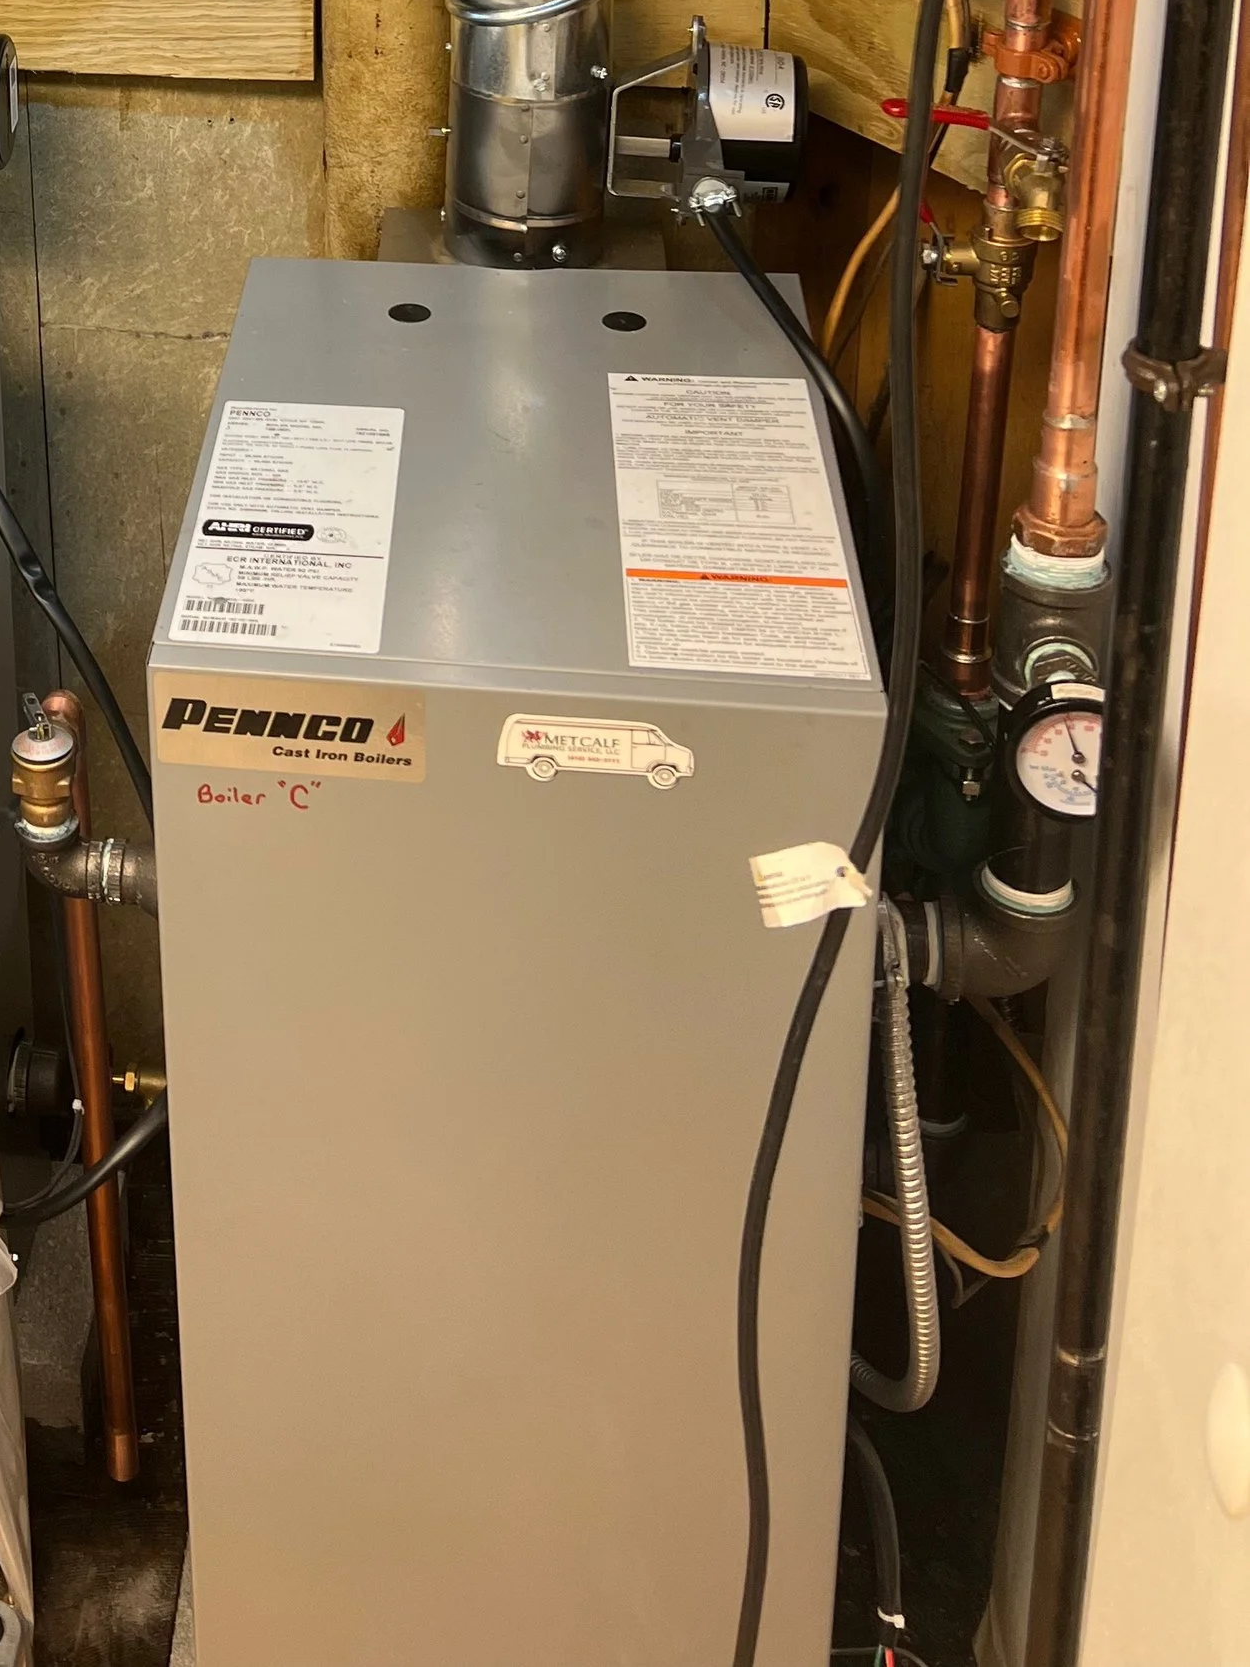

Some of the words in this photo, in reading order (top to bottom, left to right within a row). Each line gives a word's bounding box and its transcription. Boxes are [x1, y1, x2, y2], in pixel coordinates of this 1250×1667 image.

[208, 522, 252, 533] AHRI
[252, 526, 306, 536] CERTIFIED
[161, 697, 375, 744] PENNCO
[544, 733, 621, 748] METCALF
[272, 746, 310, 758] Cast
[315, 749, 348, 761] Iron
[354, 752, 412, 766] Boilers
[197, 784, 266, 805] Boiler
[277, 780, 321, 810] "C"
